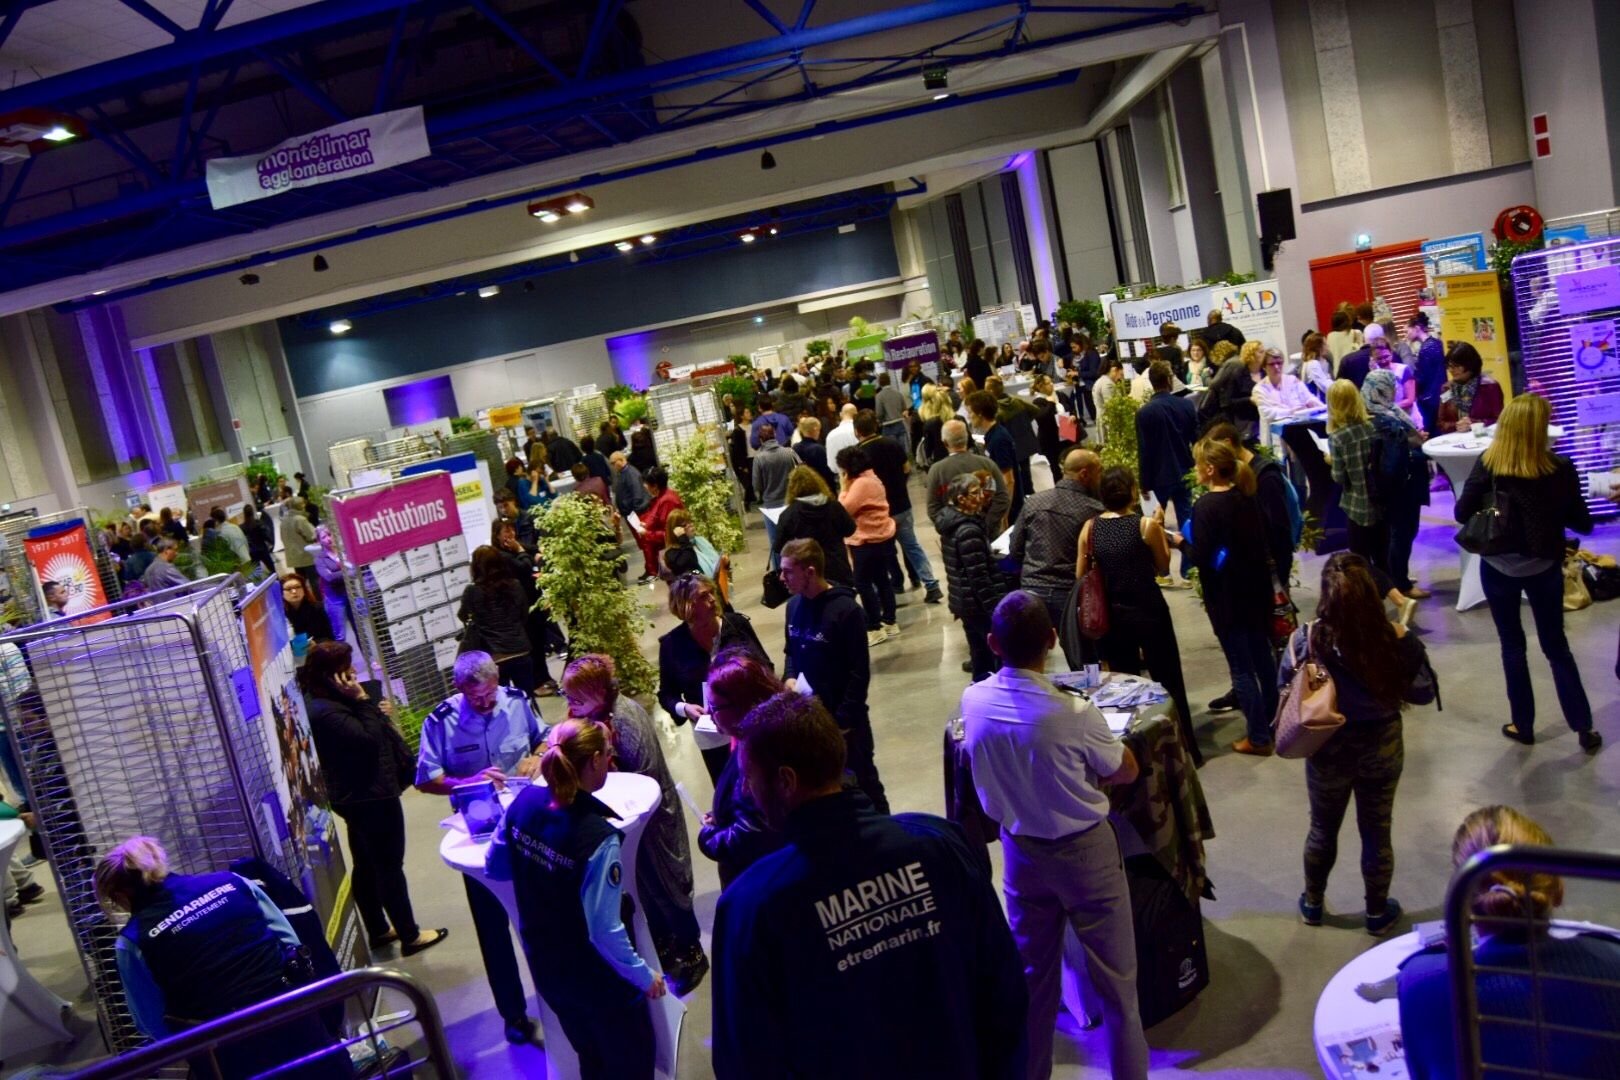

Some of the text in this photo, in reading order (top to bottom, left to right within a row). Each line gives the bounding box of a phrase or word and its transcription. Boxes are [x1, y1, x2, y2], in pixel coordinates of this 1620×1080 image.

[259, 131, 368, 171] montélimar
[261, 151, 372, 188] agglomération
[1145, 304, 1202, 327] Personne
[890, 341, 937, 361] Restauration
[353, 499, 447, 545] Institutions
[31, 542, 50, 554] 1977
[59, 533, 79, 546] 2017
[148, 883, 236, 938] GENDARMERIE
[171, 896, 229, 935] RECRUTEMENT
[814, 862, 930, 929] MARINE
[827, 896, 937, 951] NATIONALE
[837, 919, 941, 971] etremarin.fr
